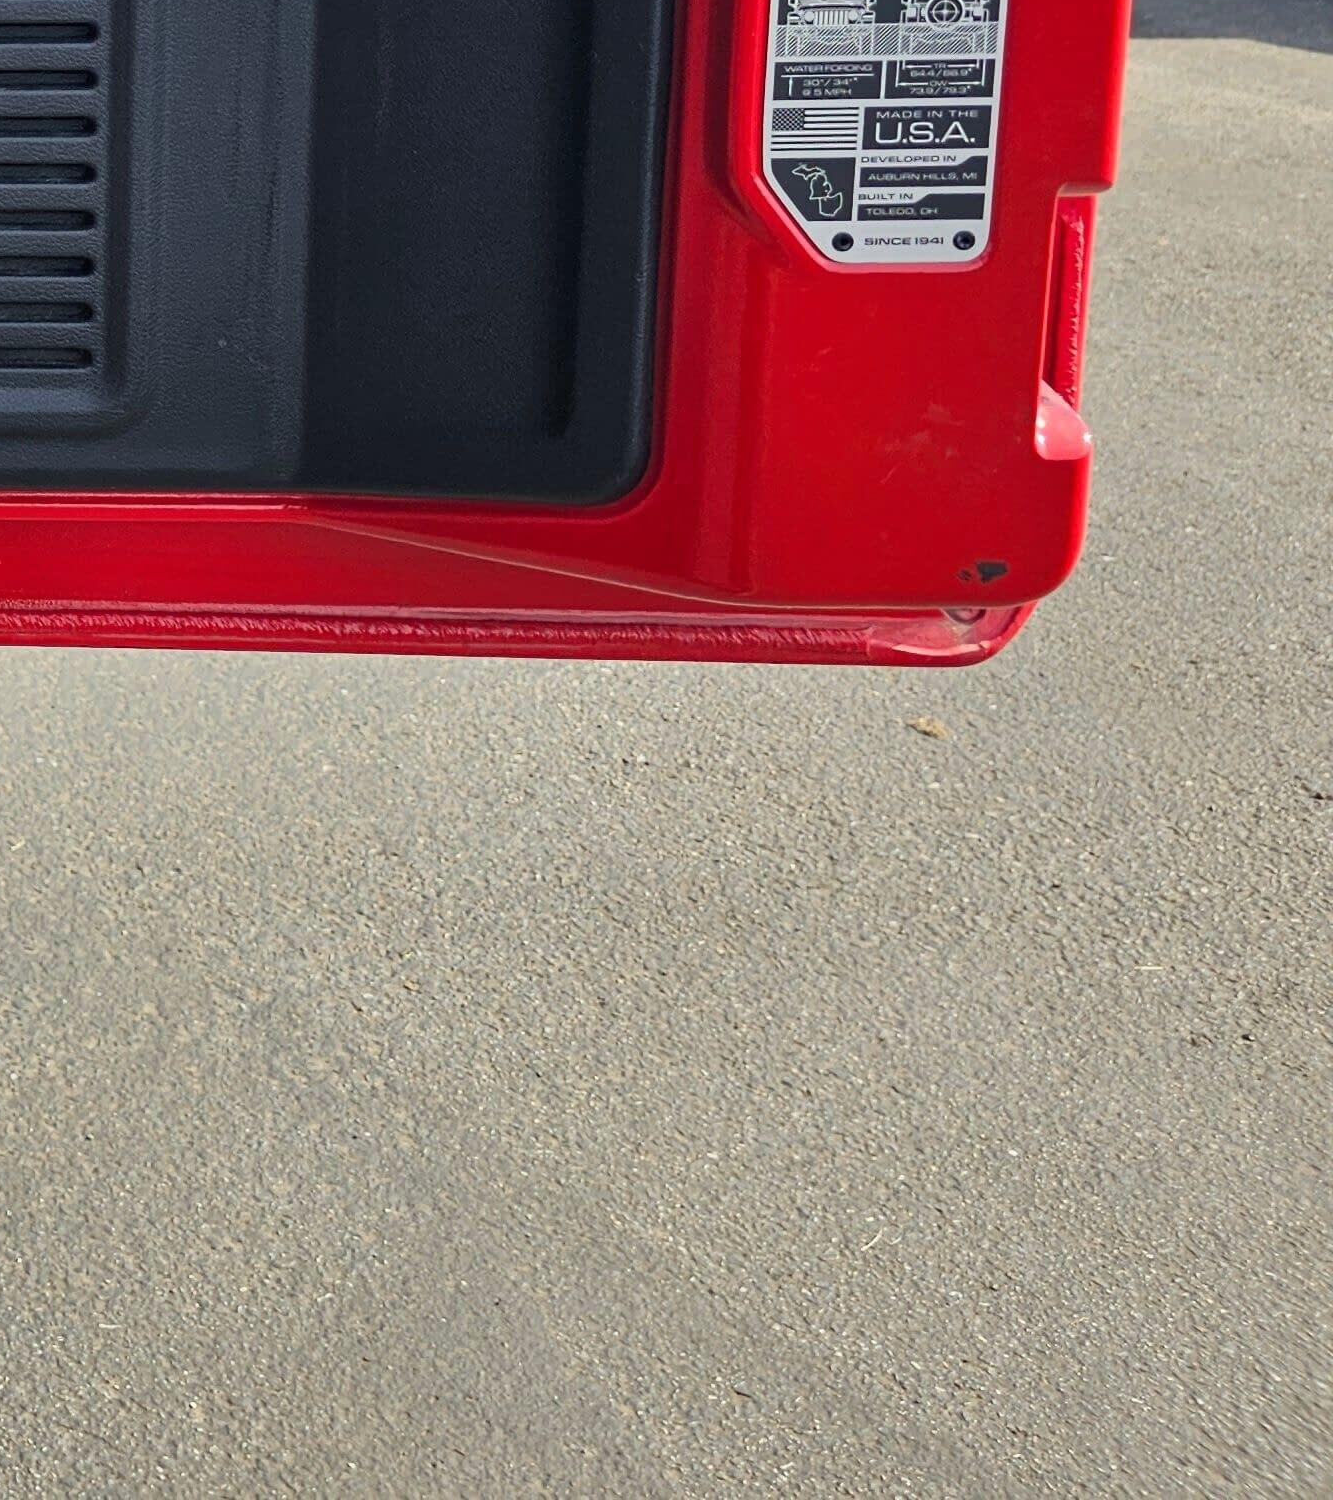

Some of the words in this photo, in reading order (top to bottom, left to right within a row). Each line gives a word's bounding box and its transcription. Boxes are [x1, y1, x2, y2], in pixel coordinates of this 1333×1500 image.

[784, 65, 823, 73] WATER
[824, 88, 852, 96] MPH
[876, 111, 923, 119] MADE
[928, 110, 944, 118] IN
[950, 110, 979, 118] THE
[874, 121, 976, 144] U.S.A.
[861, 155, 940, 164] DEVELOPED
[943, 155, 957, 163] IN
[868, 173, 920, 181] AUBURN
[923, 172, 961, 181] HILLS,
[962, 172, 978, 180] MI
[858, 193, 896, 201] BUILT
[866, 207, 916, 216] TOLEDO,
[919, 207, 937, 215] OH
[864, 237, 912, 246] SINCE
[914, 237, 944, 245] 1941
